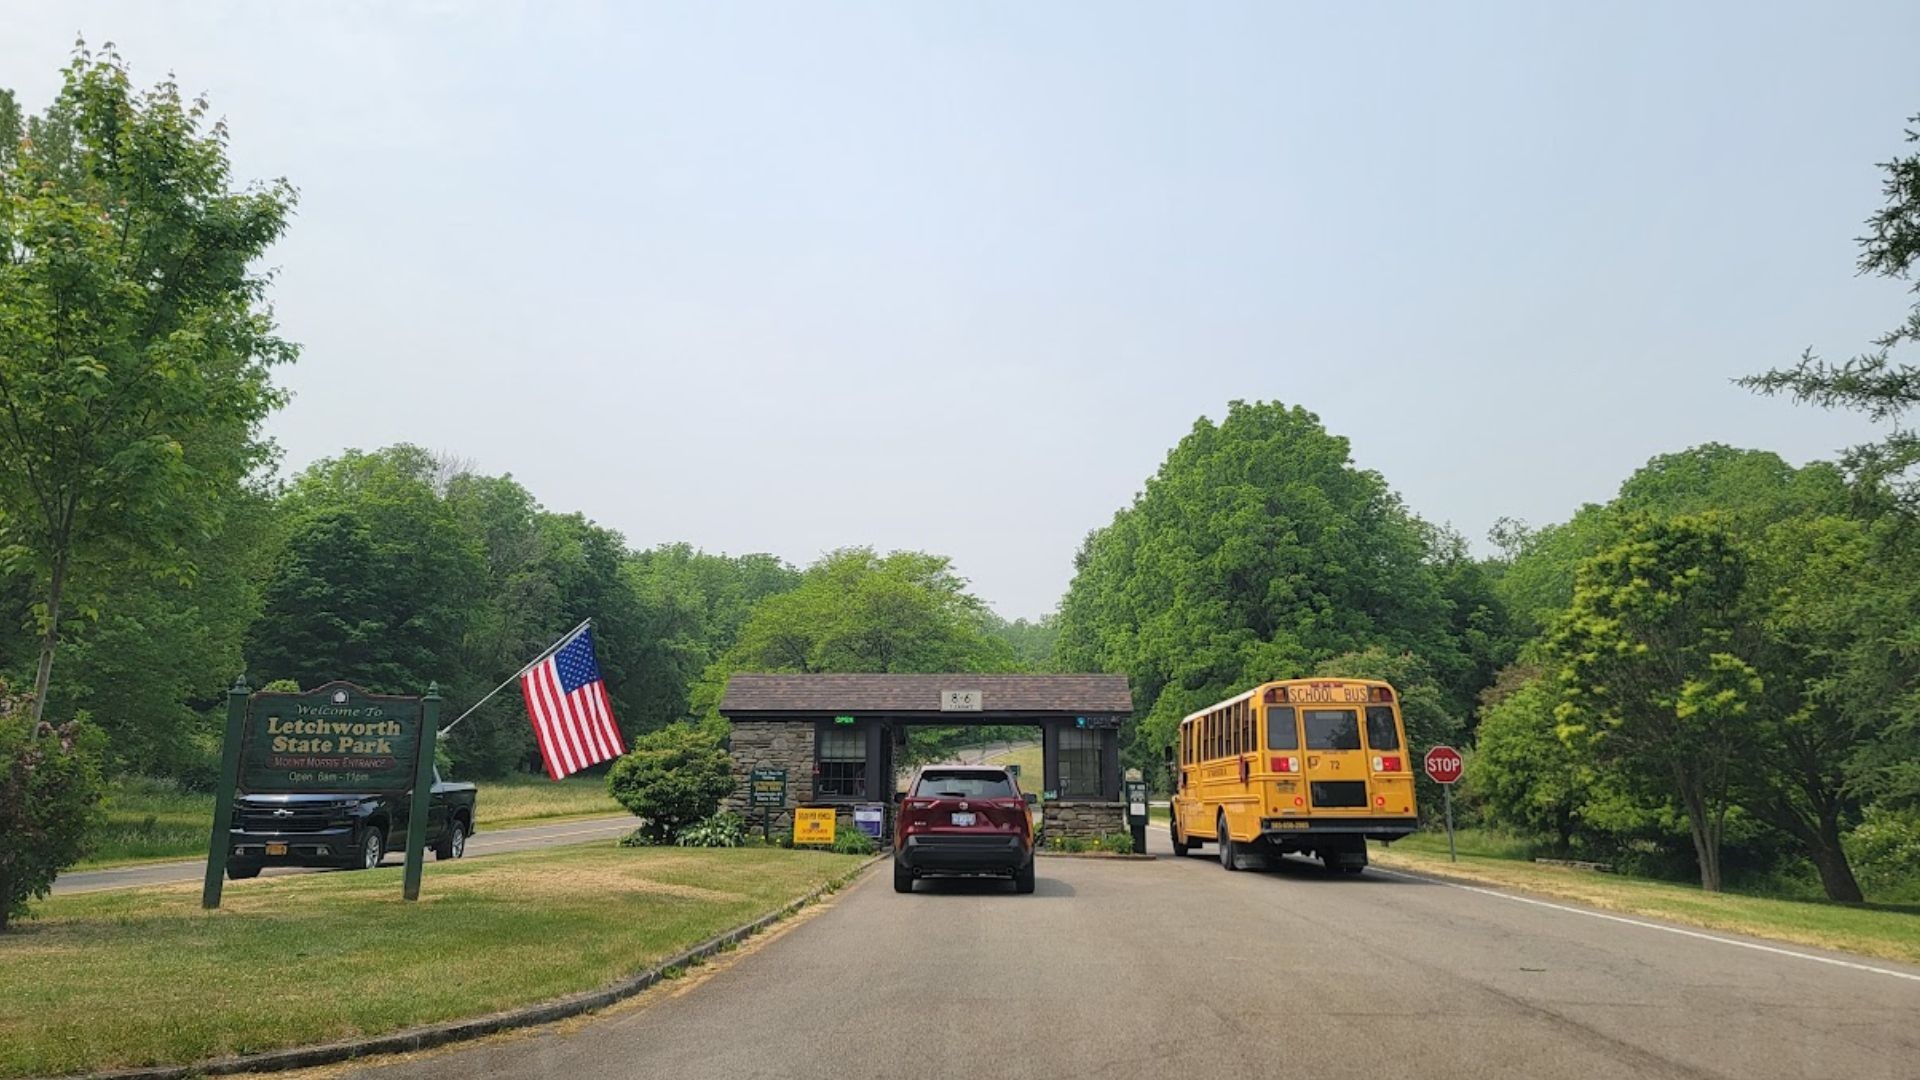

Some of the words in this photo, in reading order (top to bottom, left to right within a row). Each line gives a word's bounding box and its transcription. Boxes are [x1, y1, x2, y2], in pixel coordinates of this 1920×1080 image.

[1289, 688, 1336, 703] SCHOOL
[1344, 687, 1367, 702] BUS
[296, 704, 360, 717] Welcome
[365, 706, 383, 717] To
[267, 717, 401, 736] Letchworth
[272, 735, 333, 753] State
[338, 736, 392, 753] Park
[1329, 760, 1341, 771] 72
[1428, 757, 1460, 772] STOP
[289, 771, 313, 783] Open
[317, 771, 337, 781] 6am
[346, 772, 369, 783] 11pm
